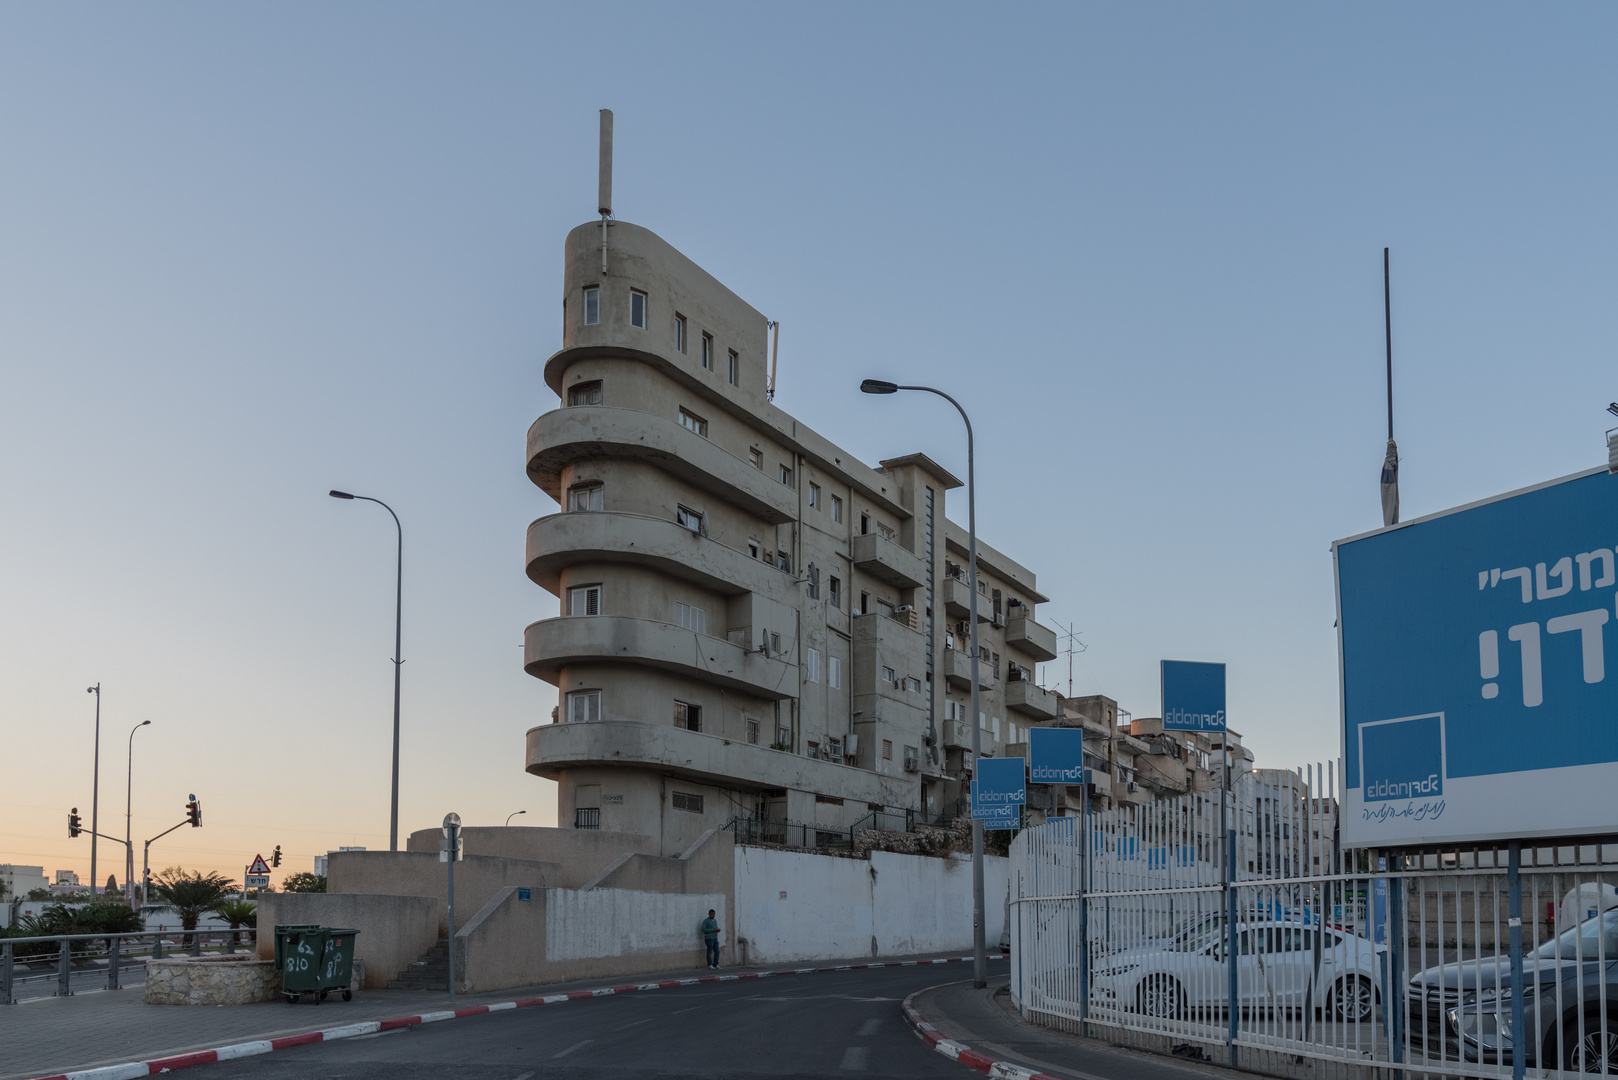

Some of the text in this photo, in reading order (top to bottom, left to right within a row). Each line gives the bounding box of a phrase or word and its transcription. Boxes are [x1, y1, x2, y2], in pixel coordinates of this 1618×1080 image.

[1478, 546, 1618, 604] מטר"
[1478, 591, 1618, 708] דן!
[287, 956, 308, 972] 810
[298, 940, 314, 955] 62
